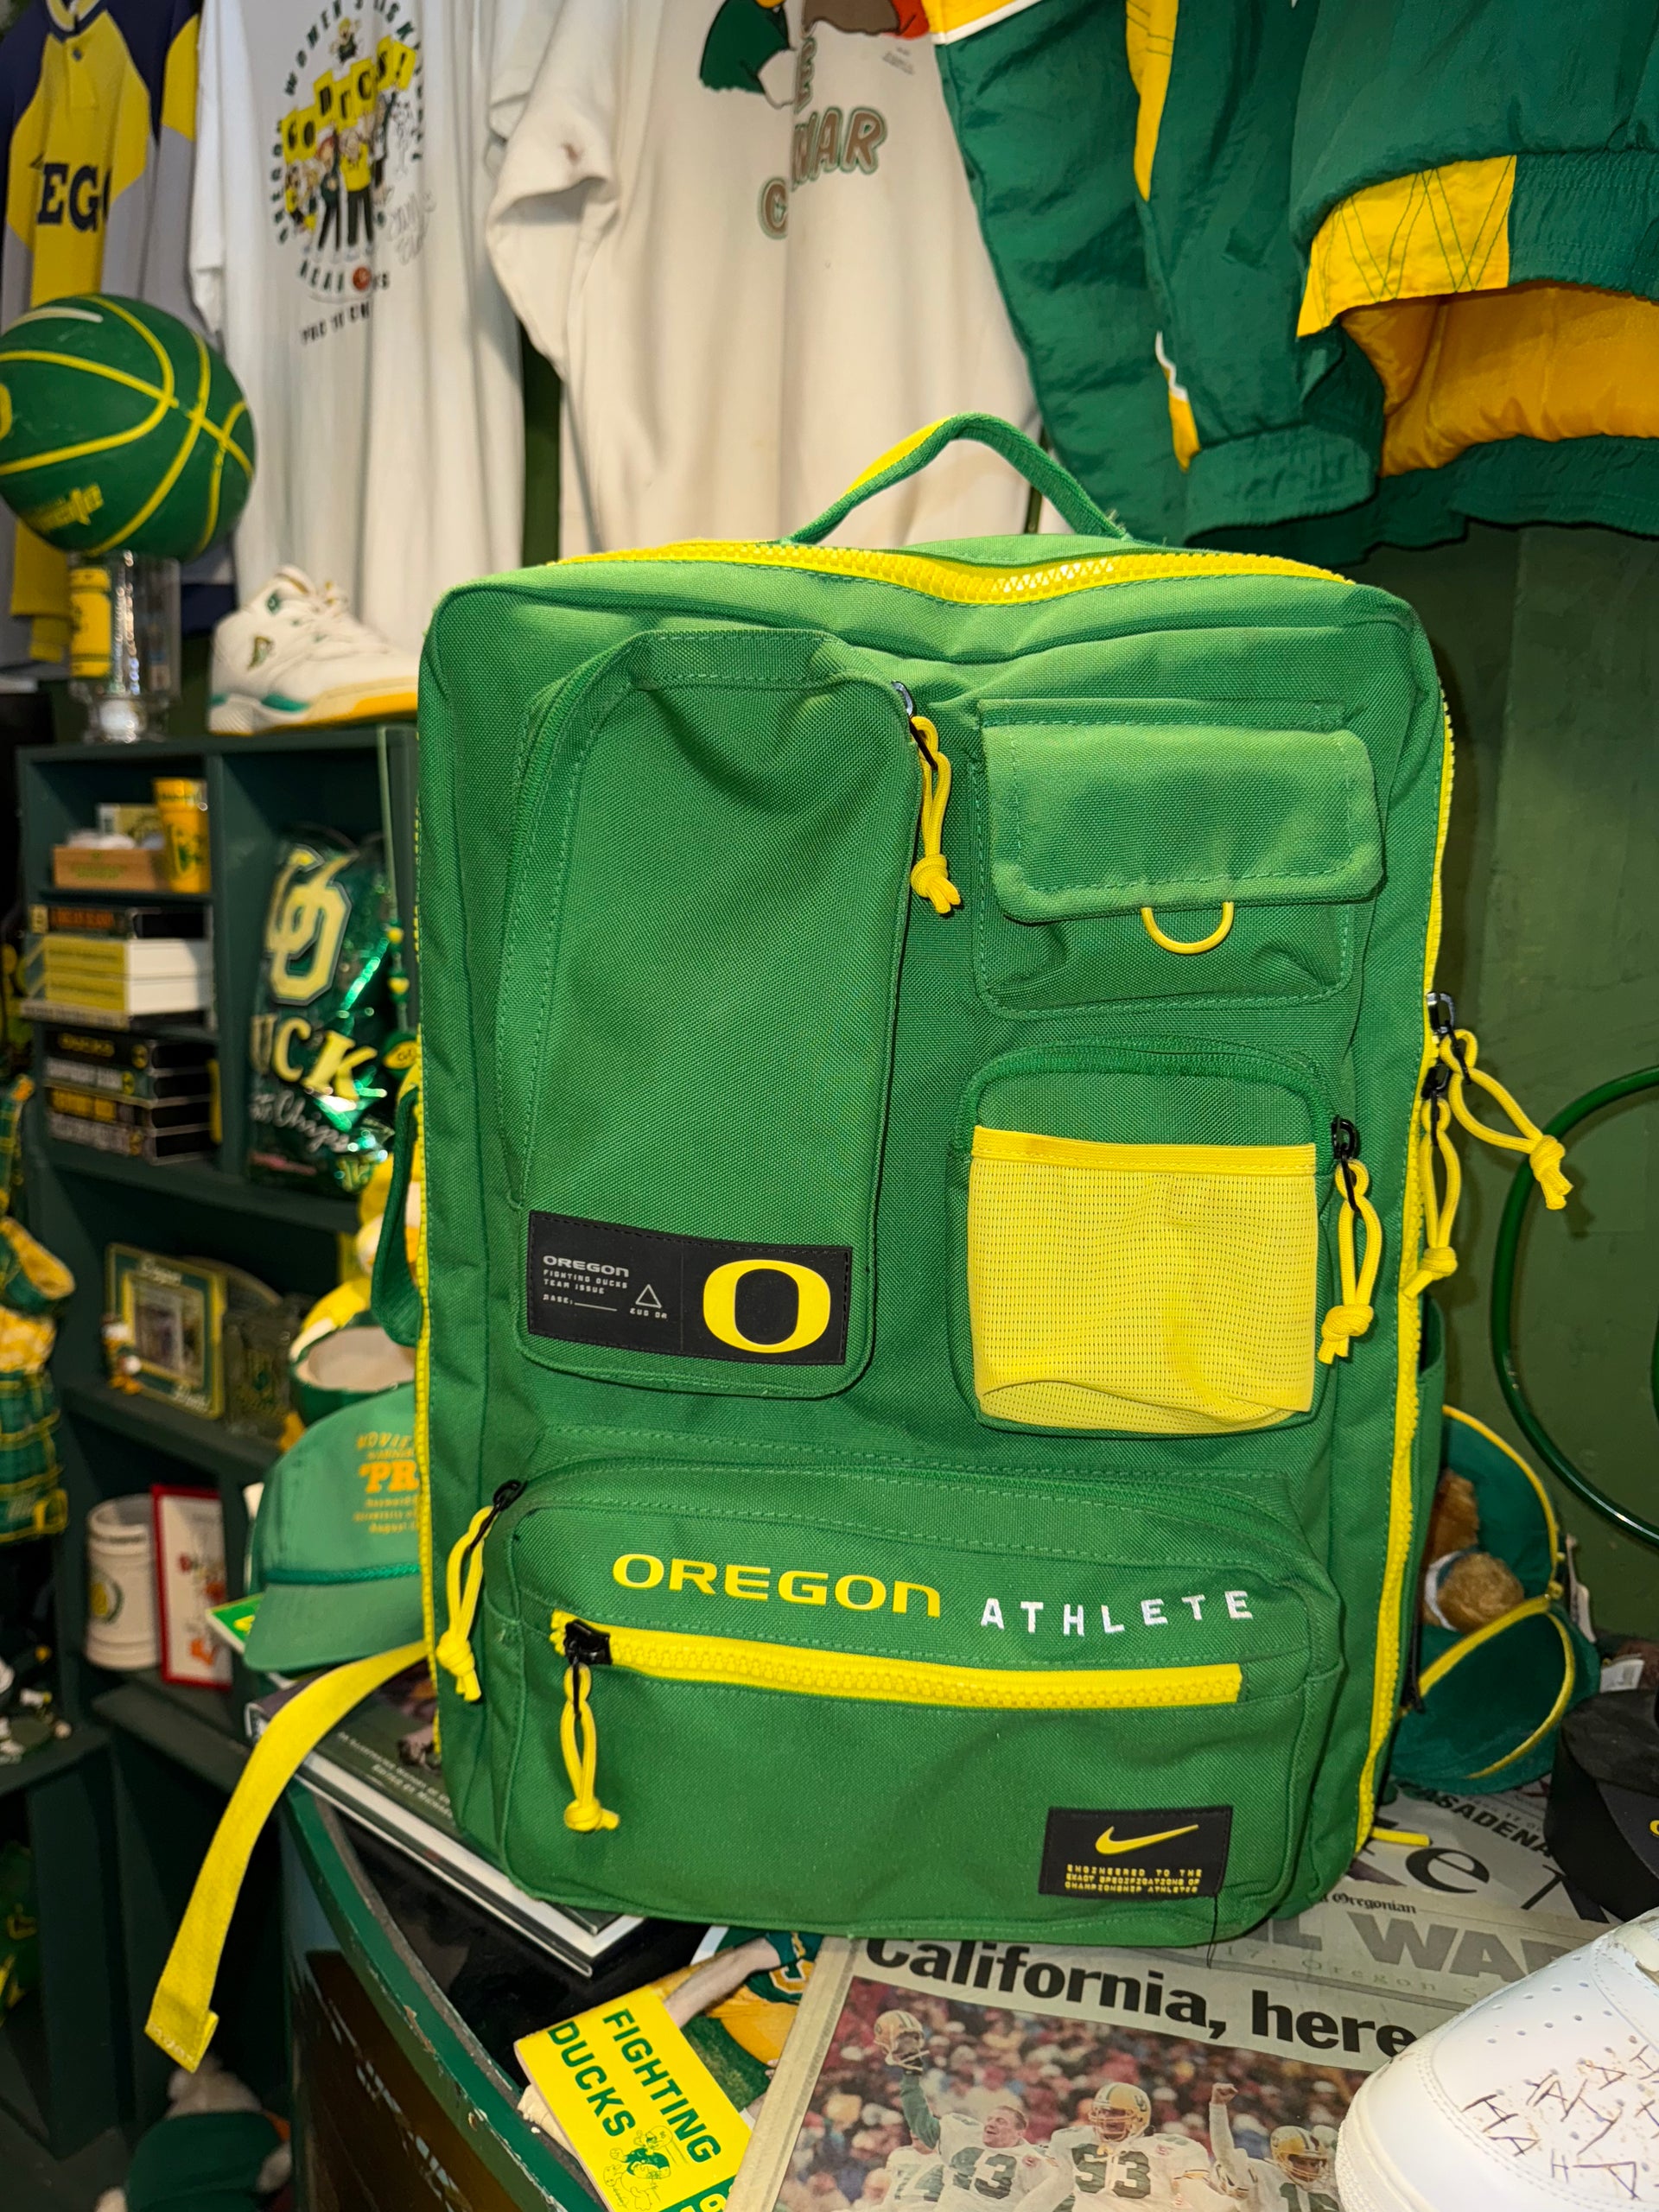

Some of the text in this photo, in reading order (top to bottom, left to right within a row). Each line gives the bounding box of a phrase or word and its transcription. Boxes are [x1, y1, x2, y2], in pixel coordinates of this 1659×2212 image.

[543, 1255, 629, 1278] OREGON
[543, 1268, 628, 1289] FIGHTING DUCKS
[543, 1278, 605, 1295] TEAM ISSUE
[702, 1258, 831, 1354] O
[612, 1553, 1254, 1637] OREGON ATHLETE
[1067, 1864, 1203, 1878] ENGINEERED TO THE
[1332, 1892, 1417, 1914] Oregonian
[865, 1937, 1227, 2039] California,
[546, 2020, 637, 2138] DUCKS
[602, 2007, 722, 2164] FIGHTING
